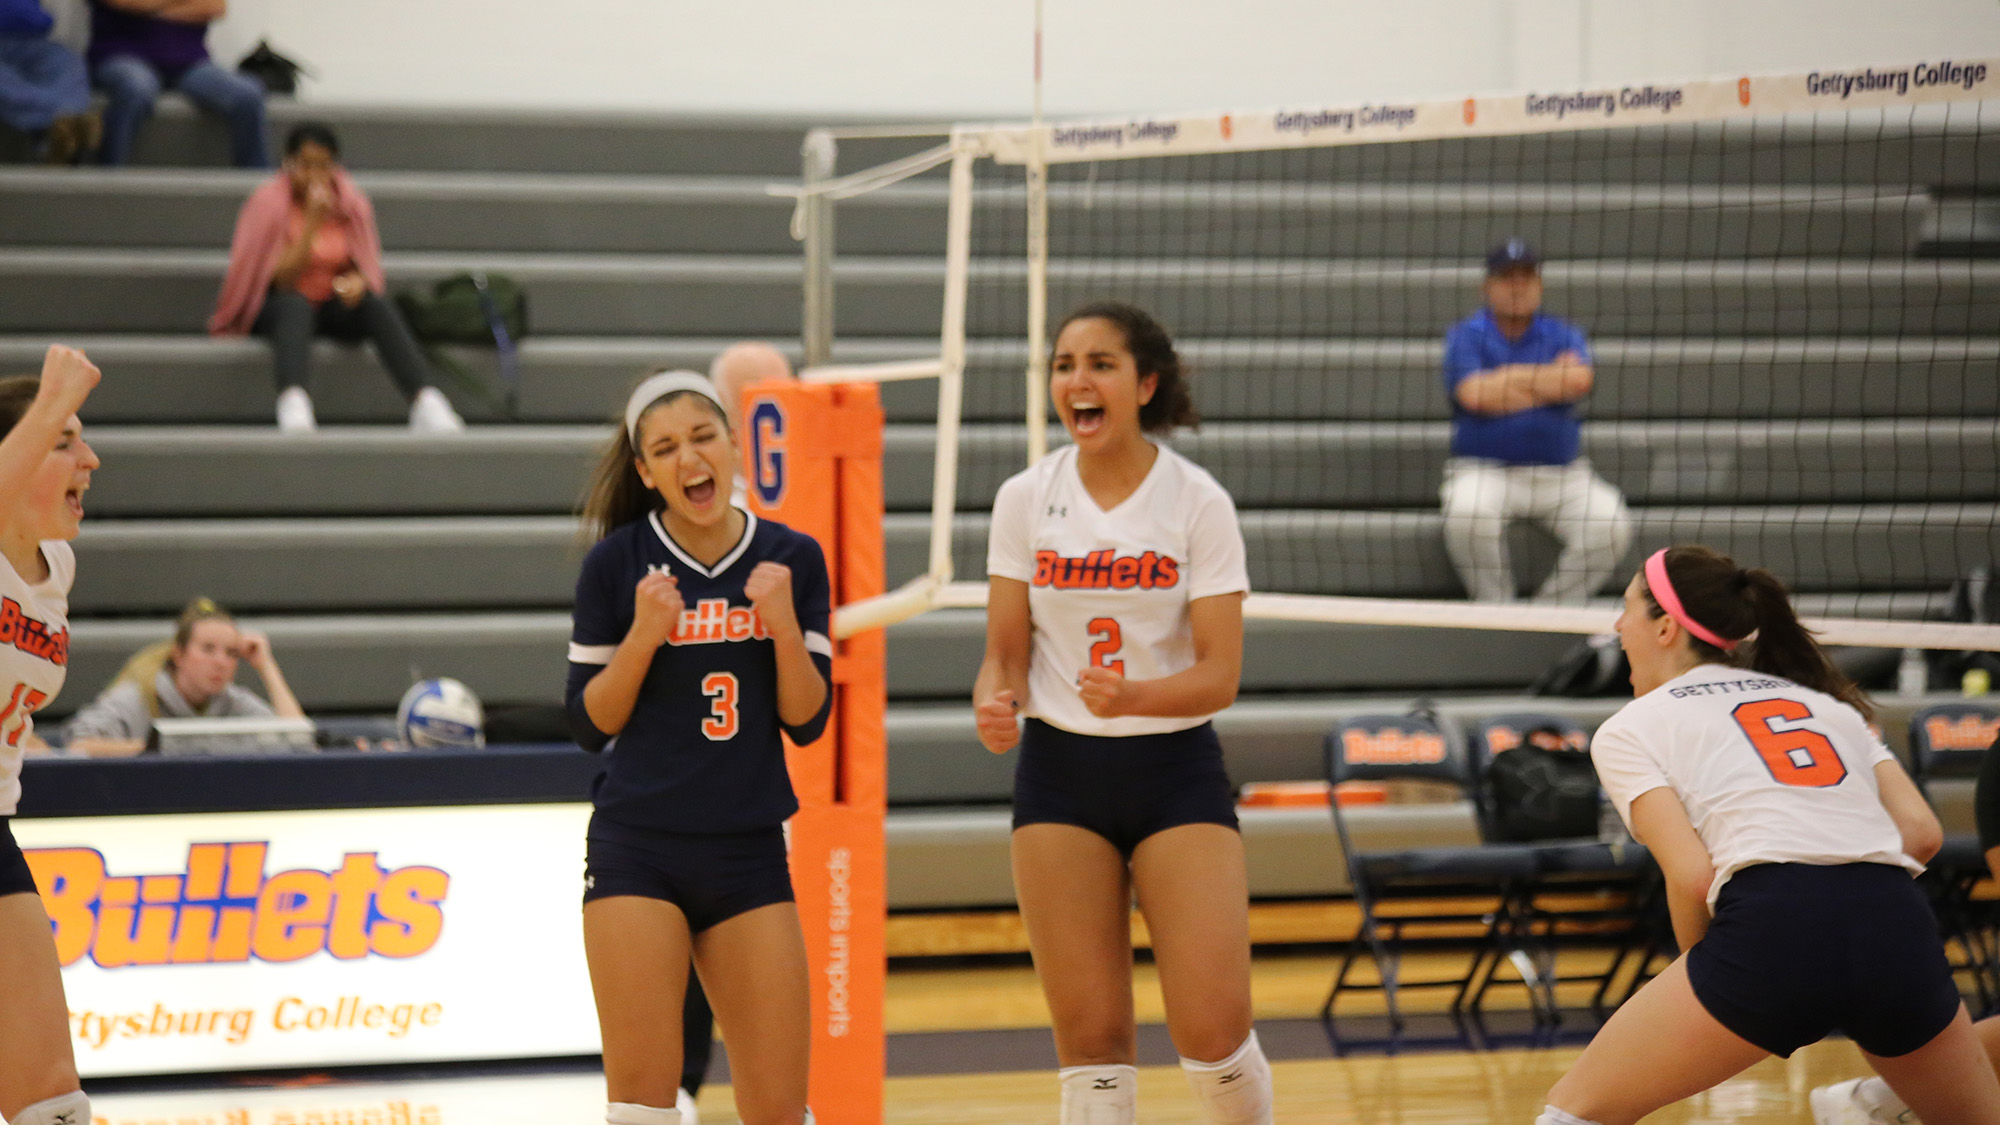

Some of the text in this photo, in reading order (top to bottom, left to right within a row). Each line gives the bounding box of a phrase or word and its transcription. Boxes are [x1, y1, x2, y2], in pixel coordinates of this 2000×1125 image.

[1619, 87, 1682, 113] College
[1806, 60, 1987, 99] Gettysburg College
[751, 400, 785, 508] G
[1032, 549, 1180, 590] Bullets
[1077, 617, 1125, 686] 2
[701, 671, 739, 741] 3
[1730, 697, 1848, 788] 6
[20, 841, 451, 969] Bullets
[825, 846, 852, 1037] sports imports
[272, 996, 443, 1038] College
